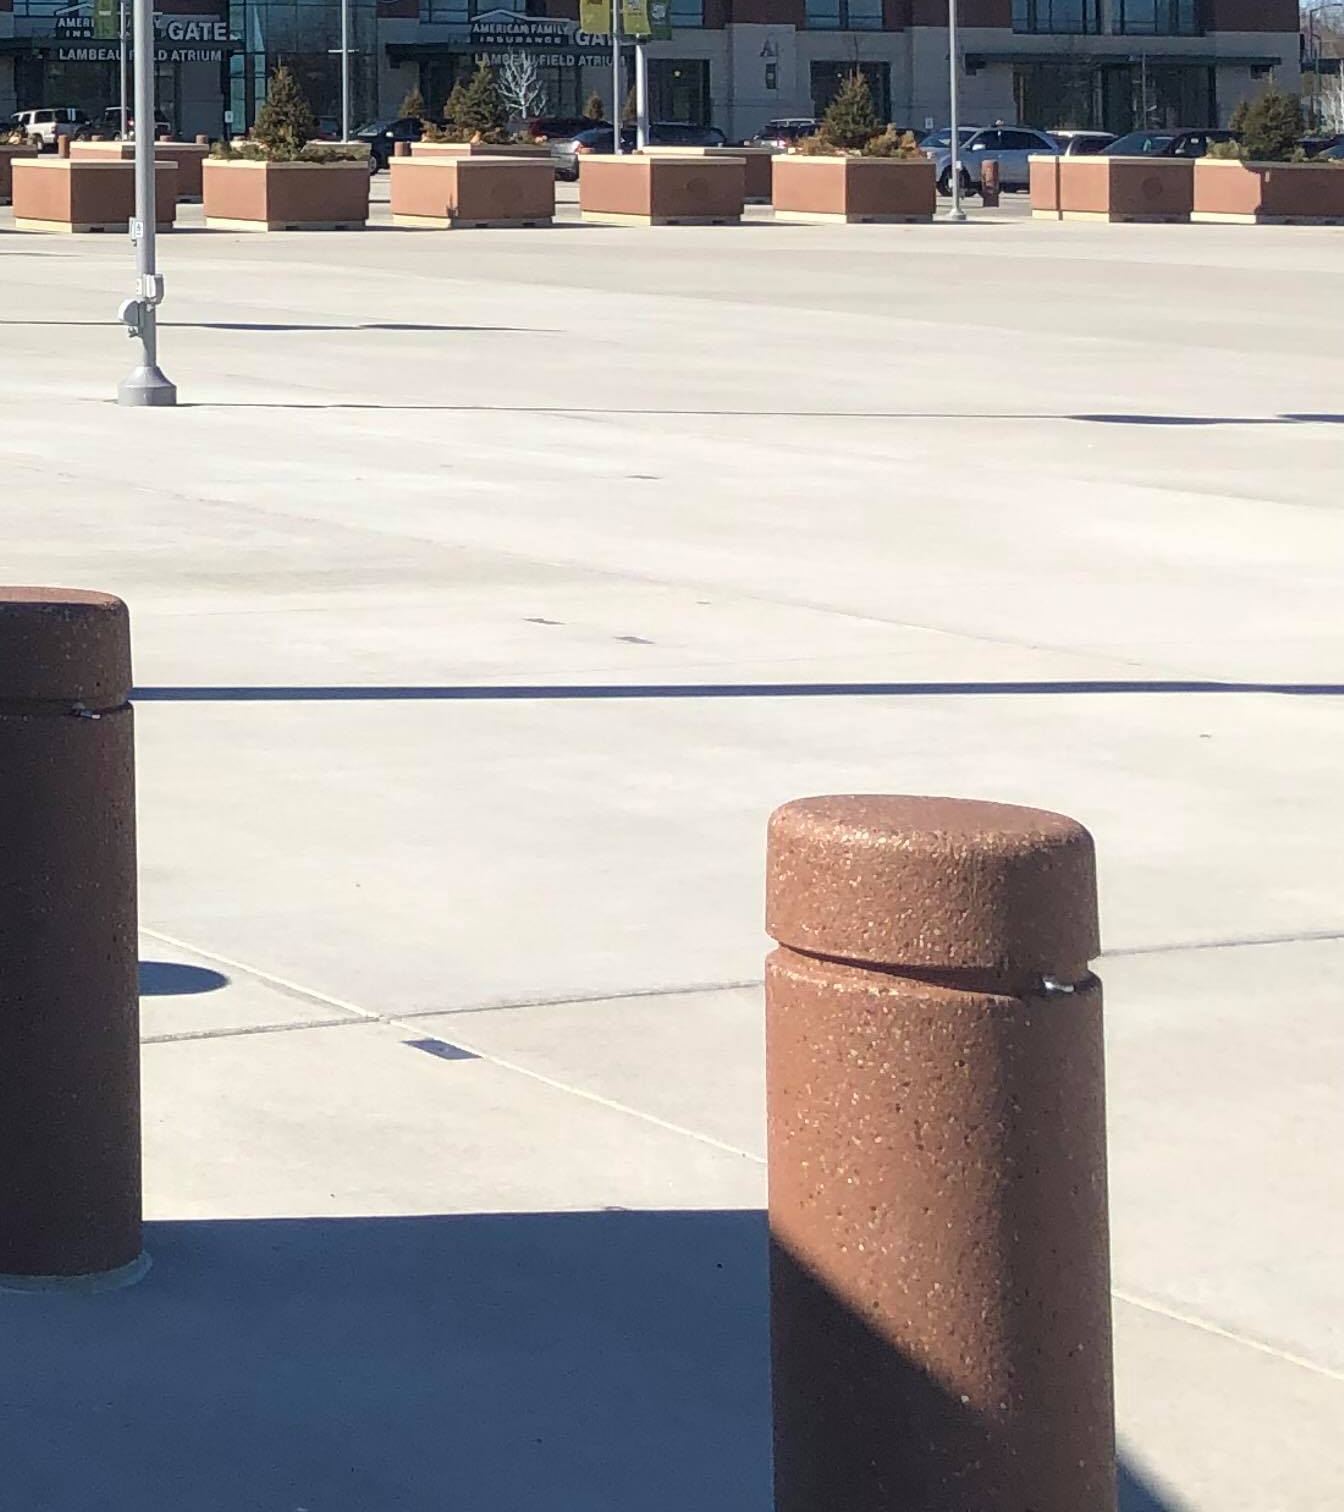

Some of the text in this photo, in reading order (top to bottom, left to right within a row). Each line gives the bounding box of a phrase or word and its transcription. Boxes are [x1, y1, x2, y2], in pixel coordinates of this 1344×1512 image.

[168, 21, 227, 41] GATE
[473, 23, 569, 35] AMERICAN FAMILY
[171, 49, 222, 62] ATRIUM
[539, 54, 575, 66] FIELD
